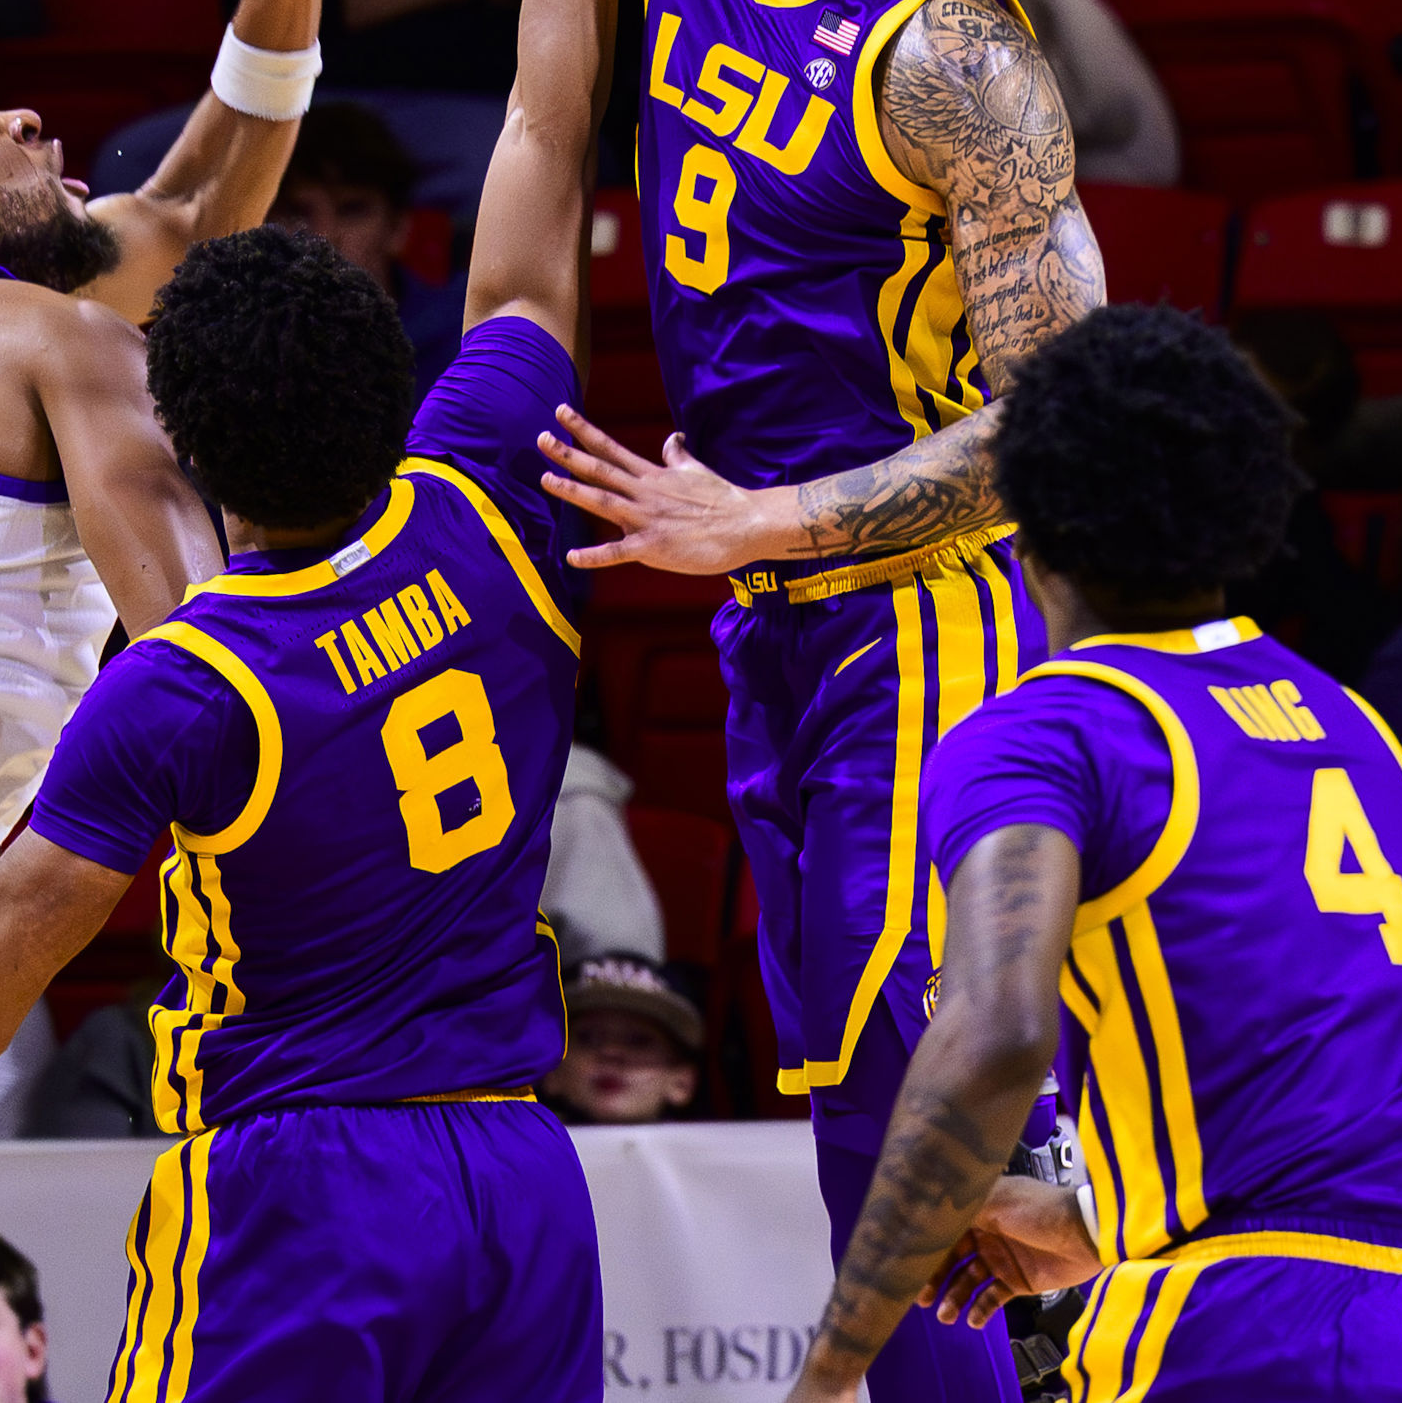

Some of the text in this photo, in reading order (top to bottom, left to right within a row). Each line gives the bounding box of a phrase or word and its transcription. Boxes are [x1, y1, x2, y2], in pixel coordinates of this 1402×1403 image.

[649, 11, 836, 176] LSU
[805, 59, 835, 89] SEC
[665, 143, 737, 295] 9
[314, 568, 472, 695] TAMBA
[745, 570, 778, 594] LSU
[380, 667, 517, 875] 8
[661, 1323, 817, 1386] FOSD
